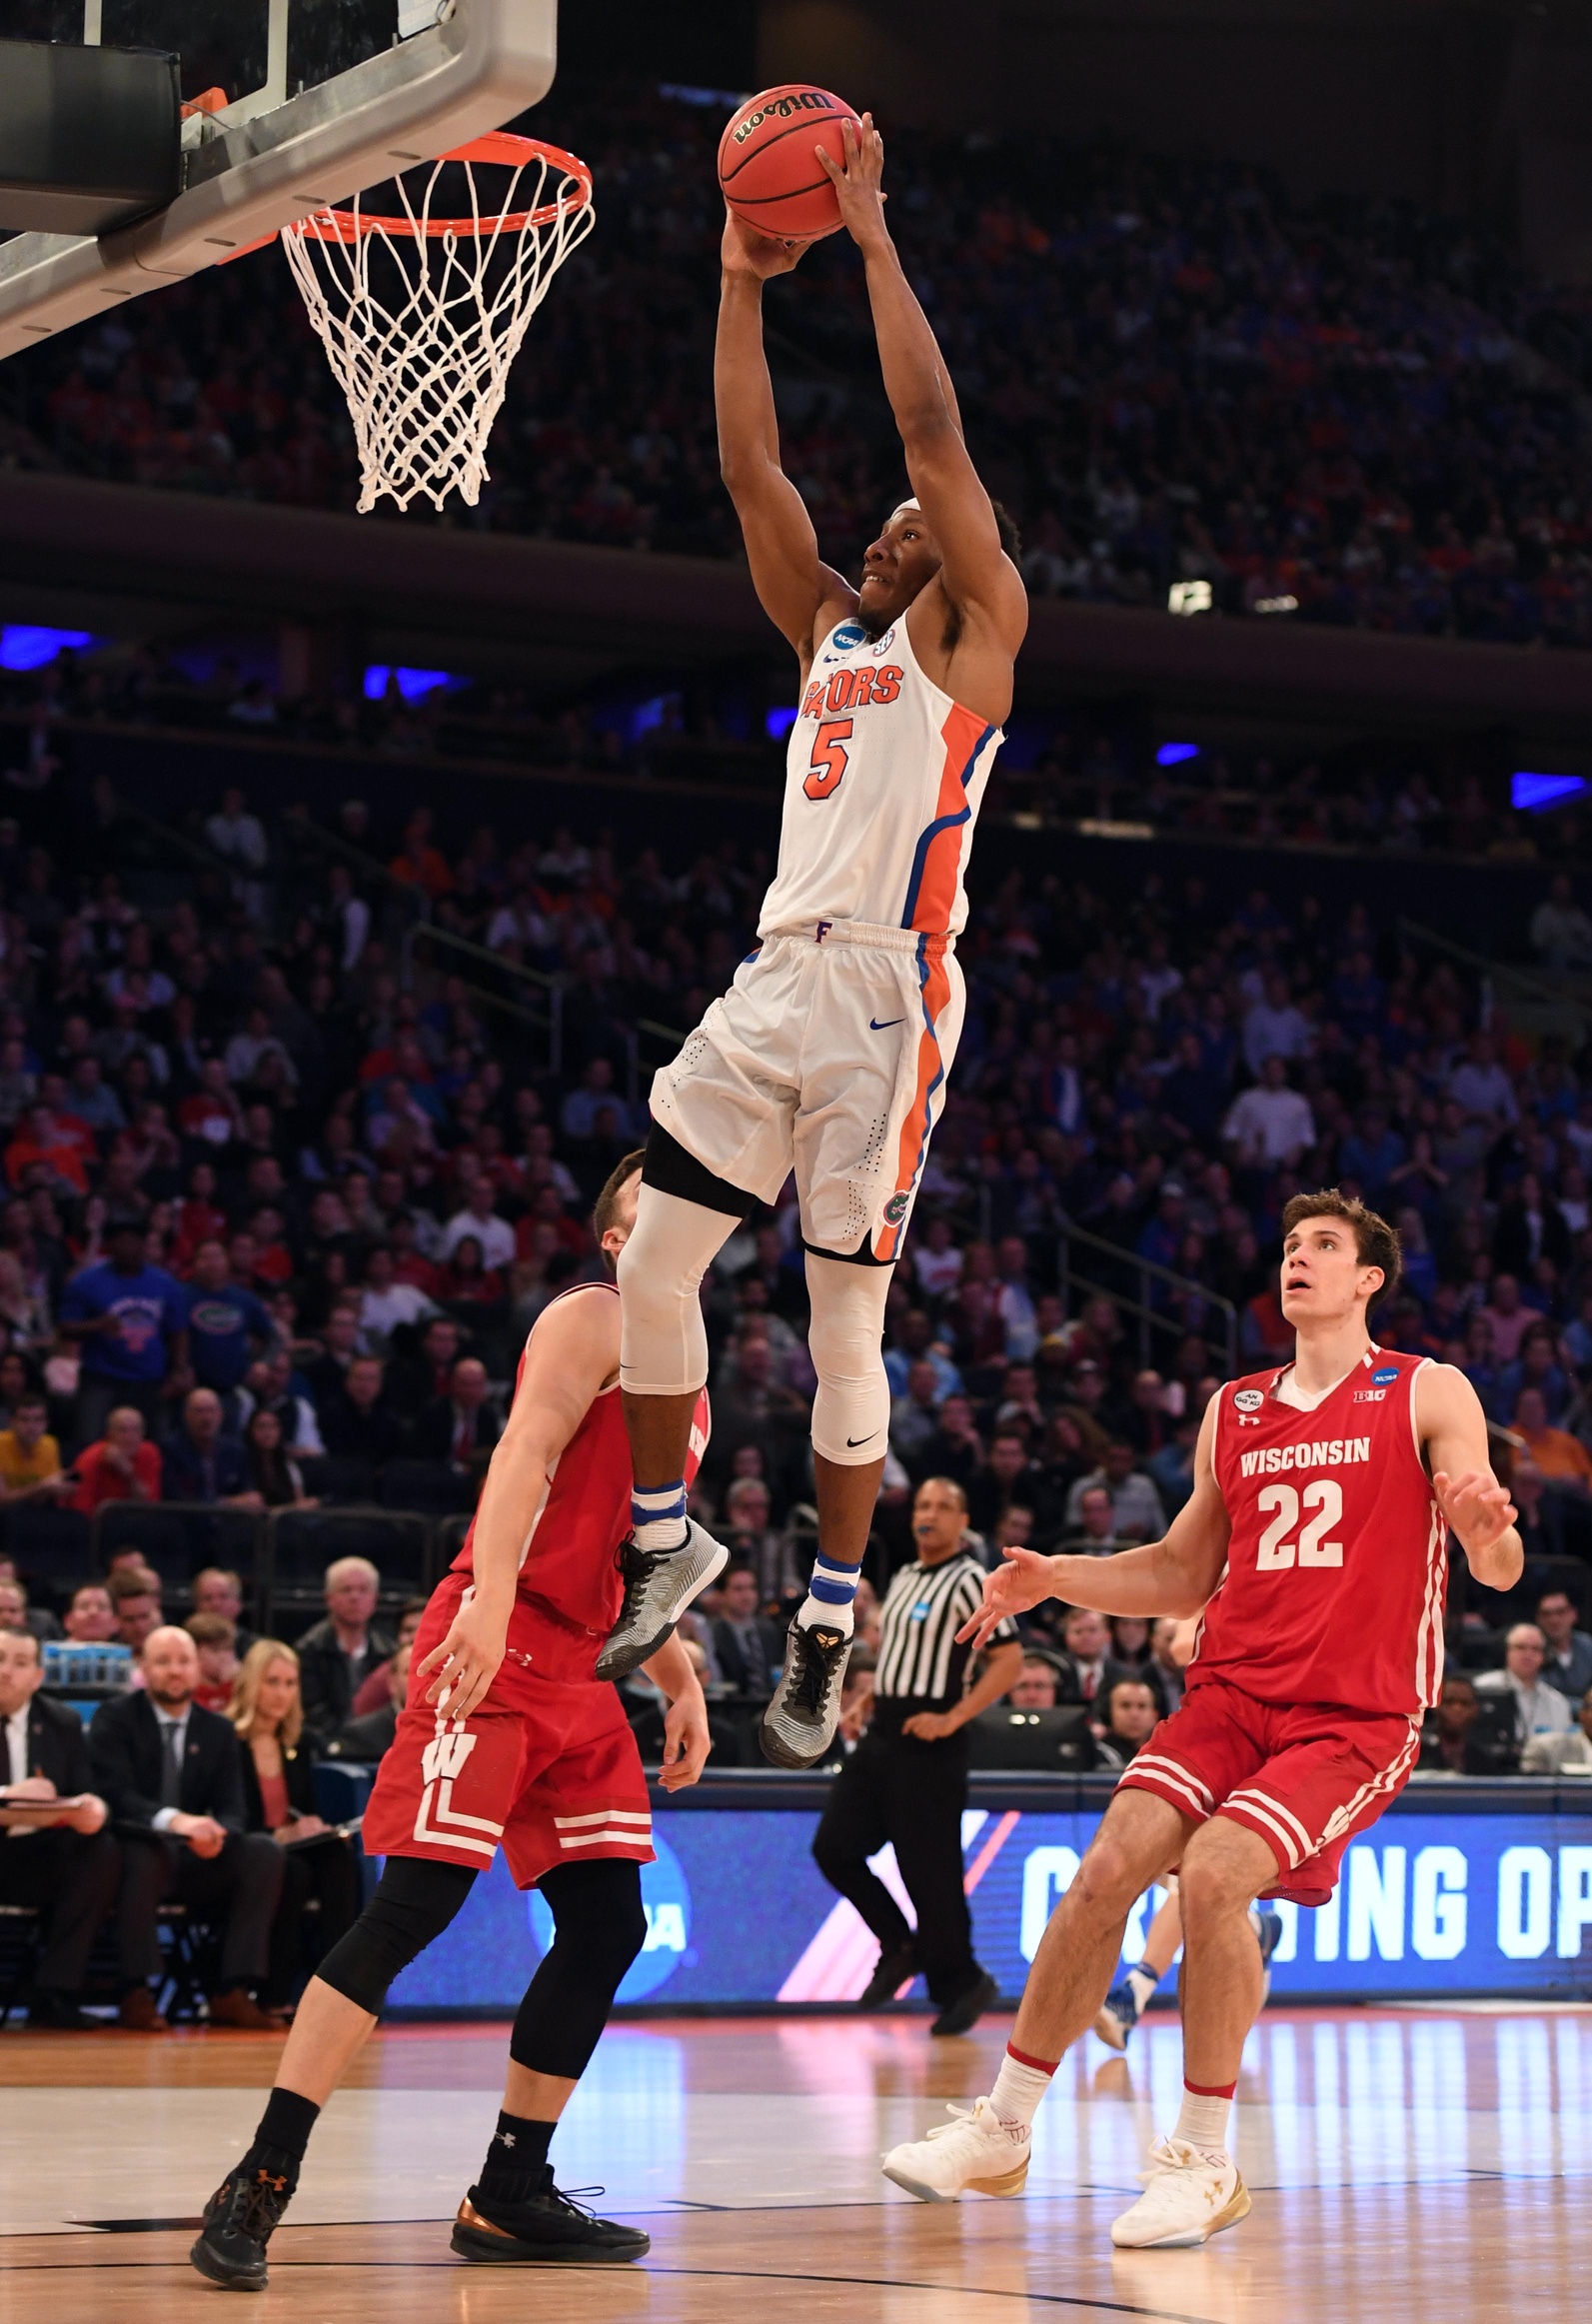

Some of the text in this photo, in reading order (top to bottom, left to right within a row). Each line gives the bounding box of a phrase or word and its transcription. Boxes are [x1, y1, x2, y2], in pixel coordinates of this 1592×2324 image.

[734, 92, 835, 144] Wilson
[874, 630, 893, 655] SEC
[800, 664, 904, 720] GAORS
[802, 718, 853, 801] 5
[814, 920, 833, 945] F
[1240, 1436, 1371, 1478] WISCONSIN
[1255, 1479, 1344, 1571] 22
[421, 1733, 478, 1787] W
